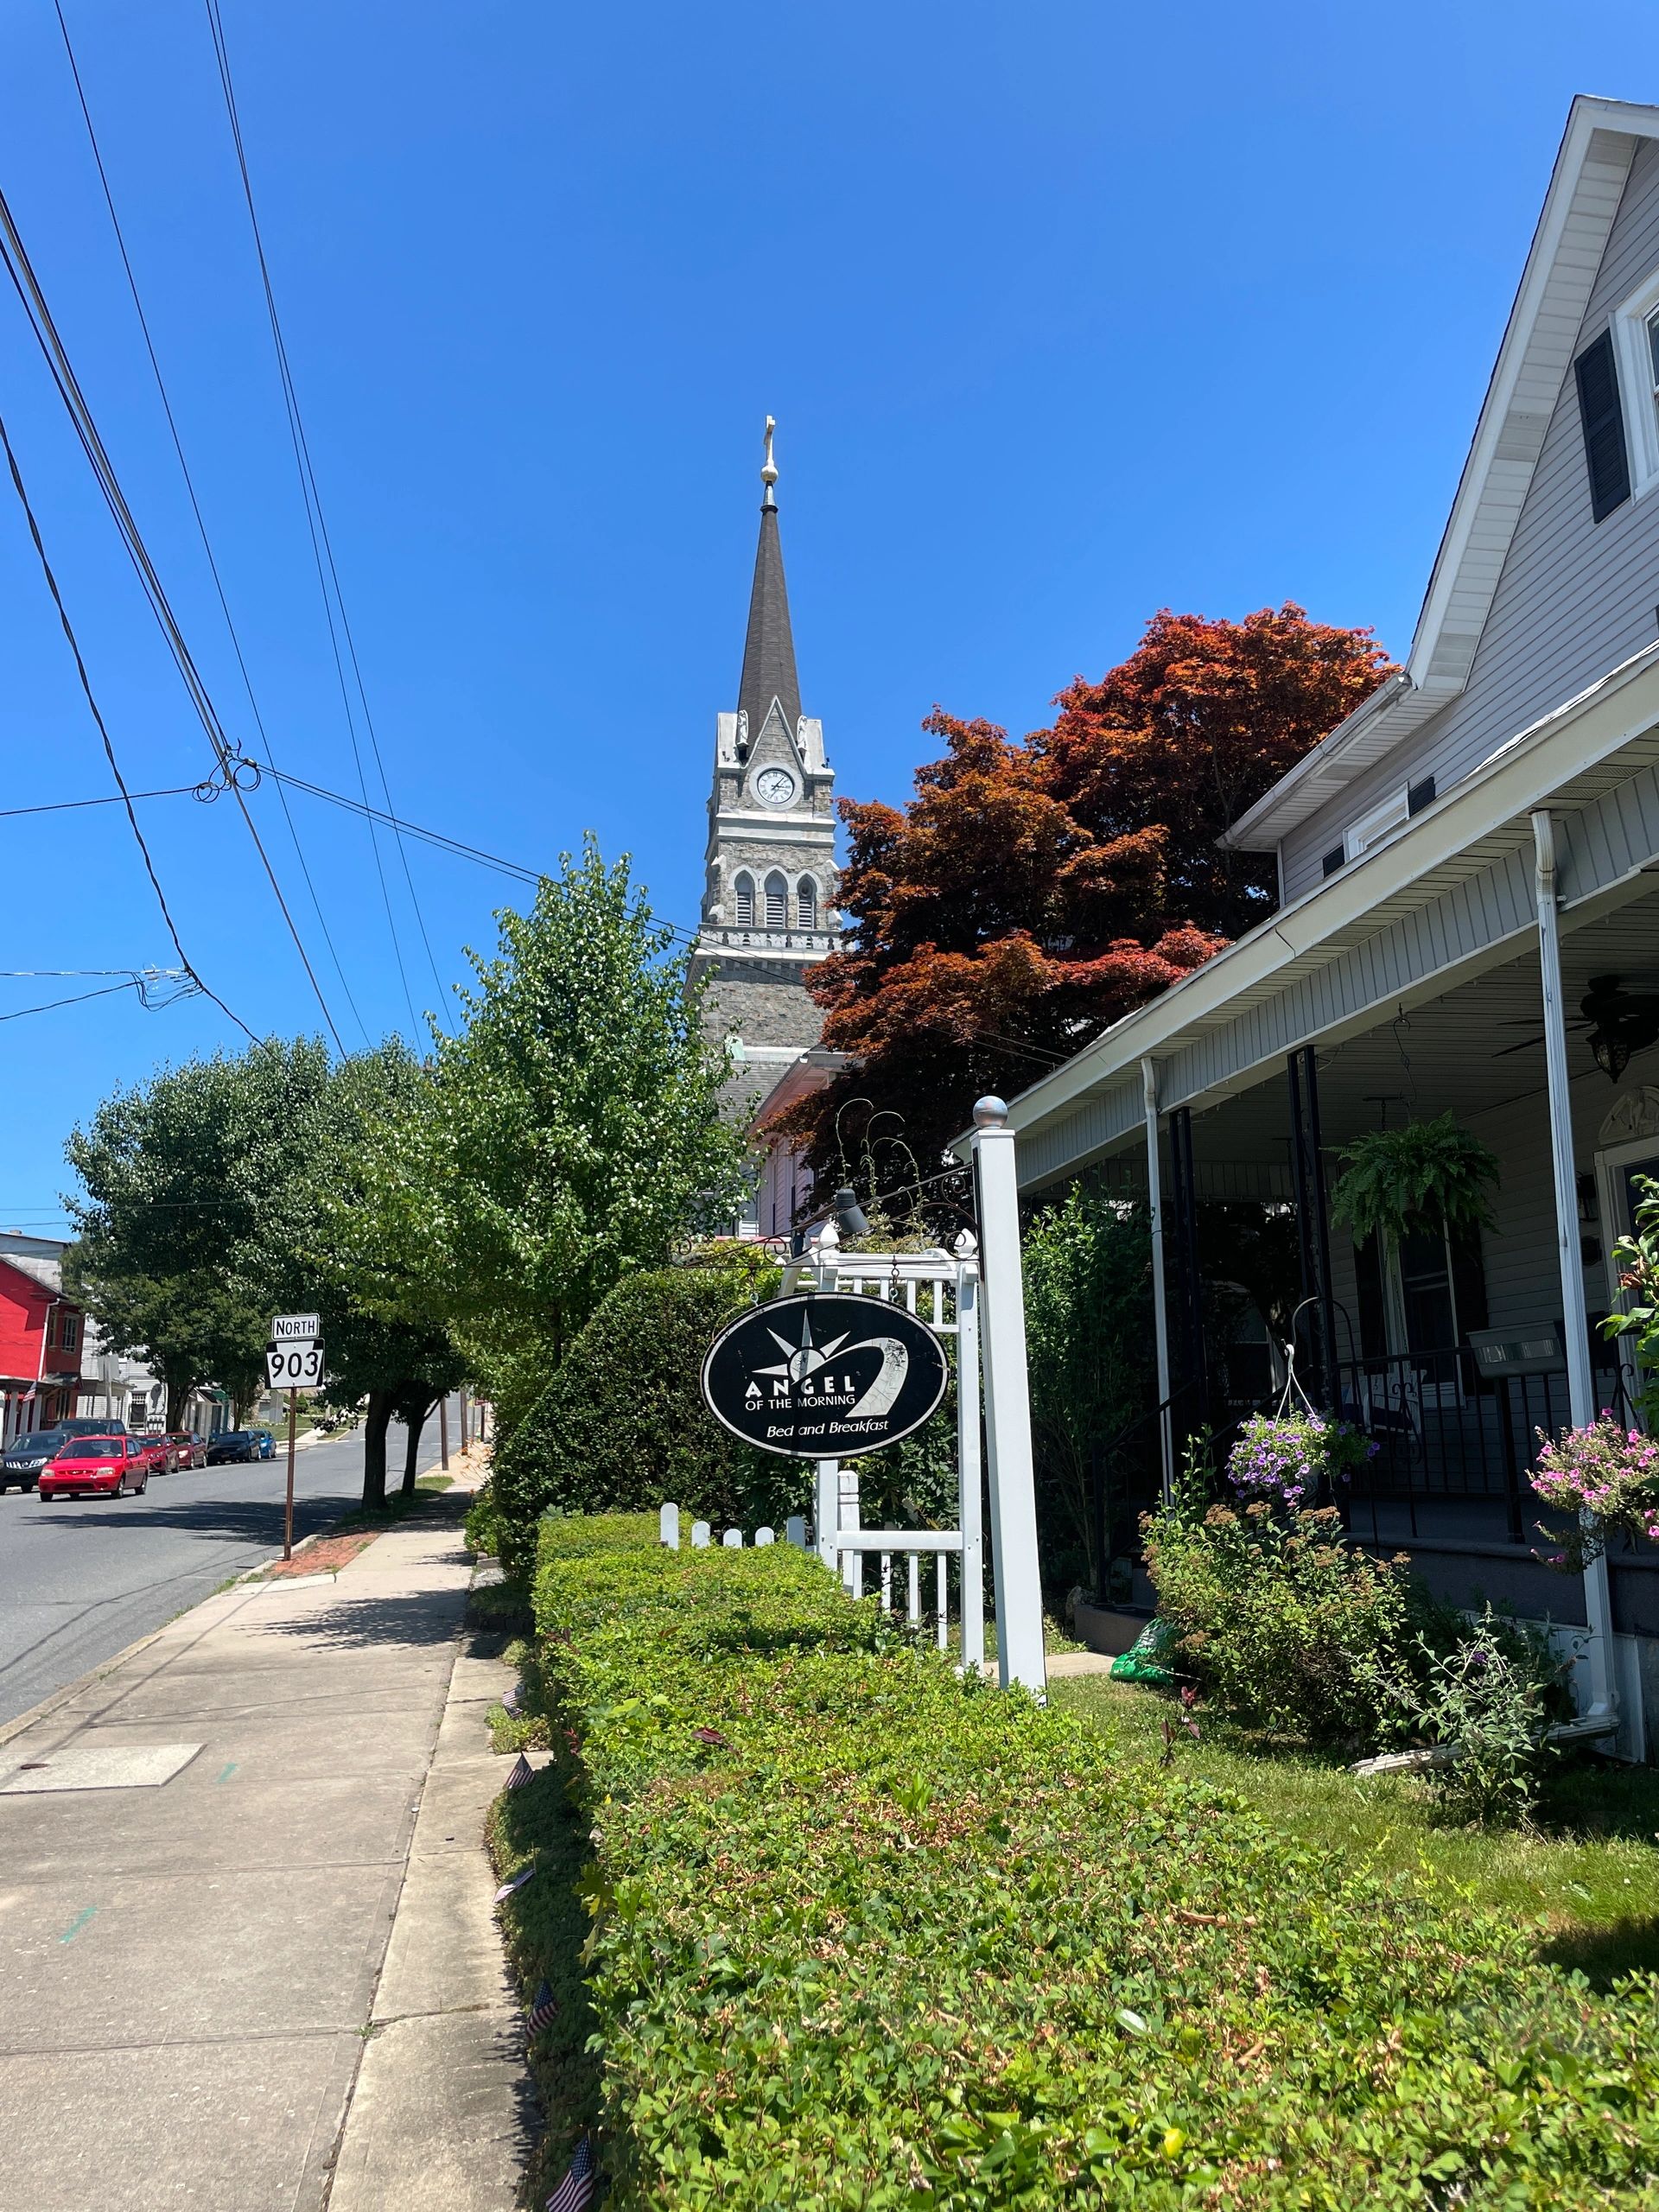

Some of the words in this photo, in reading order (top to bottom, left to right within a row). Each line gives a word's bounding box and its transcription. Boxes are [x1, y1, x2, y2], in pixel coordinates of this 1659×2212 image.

[276, 1320, 315, 1336] NORTH
[271, 1351, 319, 1378] 903
[745, 1376, 855, 1398] ANGEL
[745, 1400, 764, 1411] OF
[767, 1398, 792, 1409] THE
[797, 1394, 855, 1408] MORNING
[766, 1425, 794, 1438] Bed
[798, 1423, 825, 1435] and
[829, 1418, 889, 1433] Breakfast
